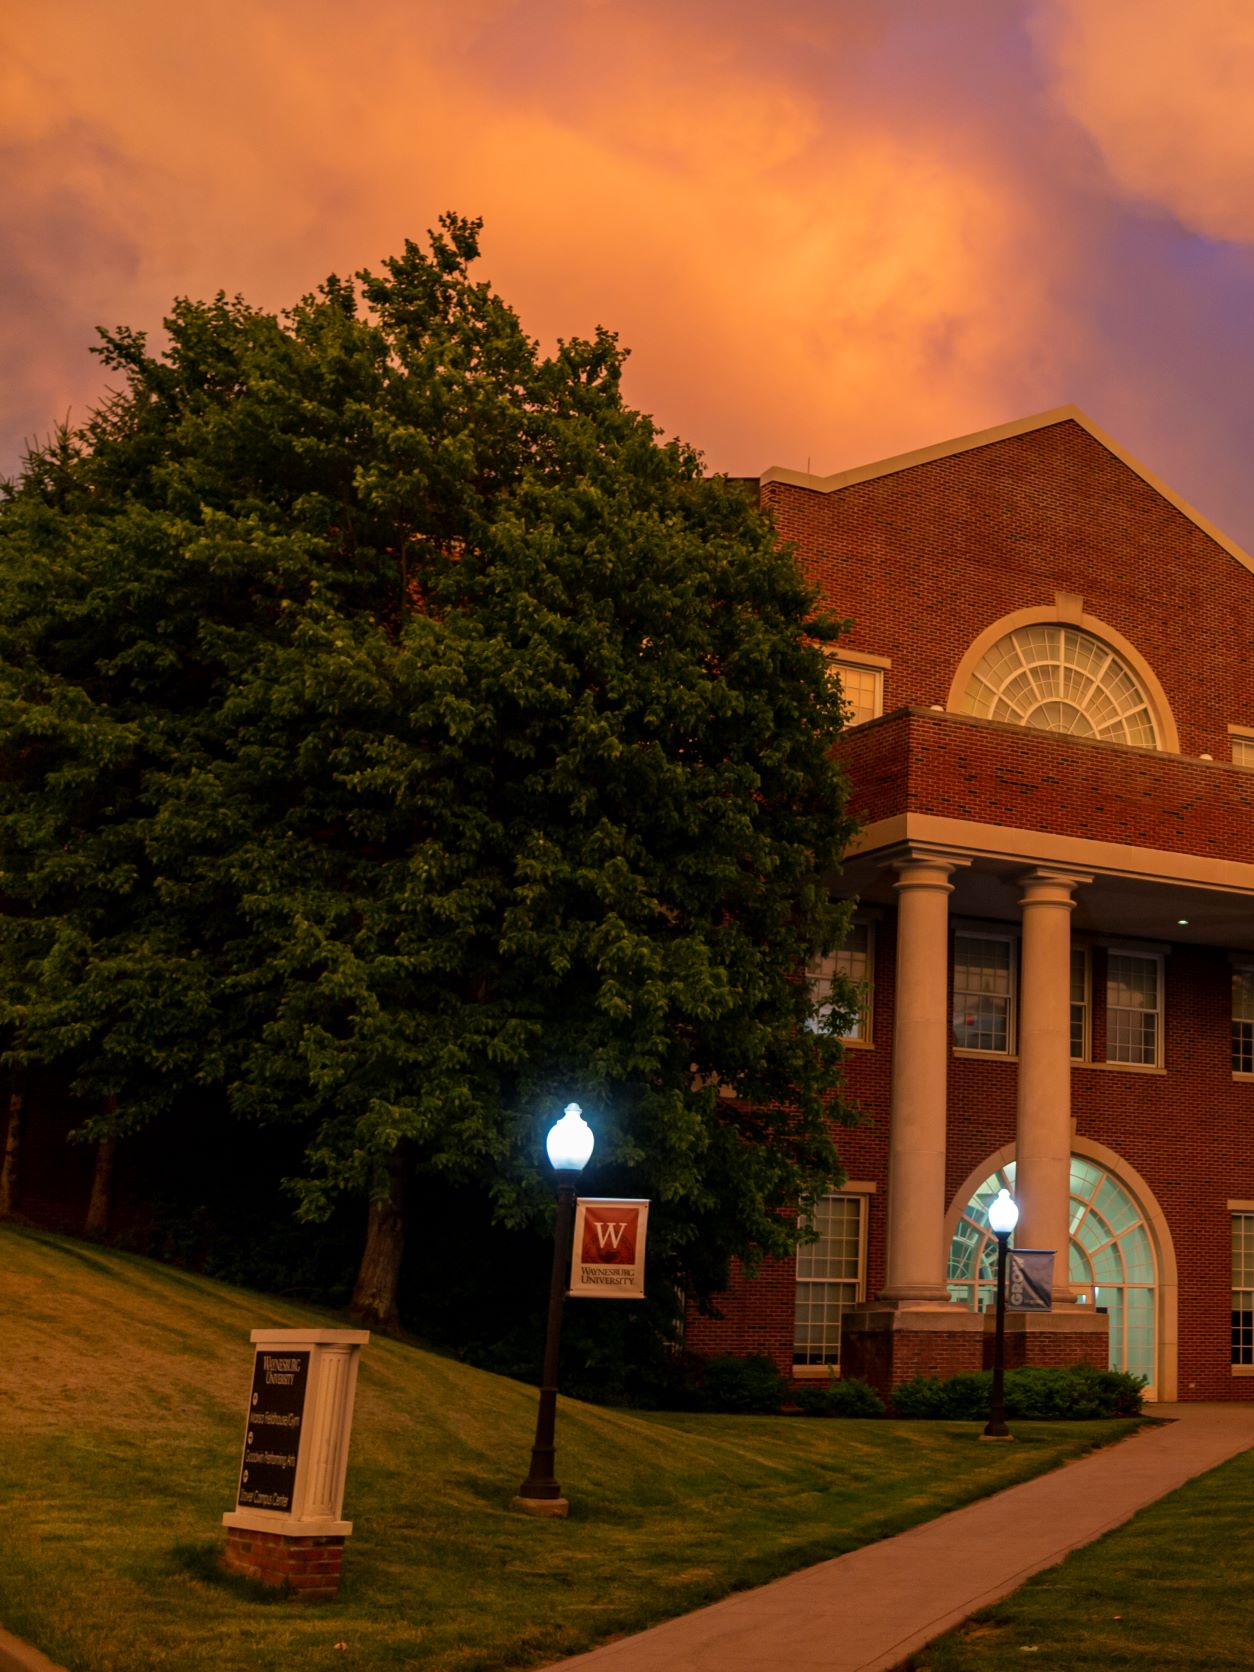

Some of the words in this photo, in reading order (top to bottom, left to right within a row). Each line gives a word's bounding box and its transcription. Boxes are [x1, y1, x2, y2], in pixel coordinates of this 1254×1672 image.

[594, 1222, 628, 1249] W
[581, 1266, 635, 1277] WAYNESBURG
[581, 1275, 635, 1286] UNIVERSITY
[263, 1355, 301, 1372] WAYNESBURG
[265, 1371, 295, 1385] UNIVERSITY
